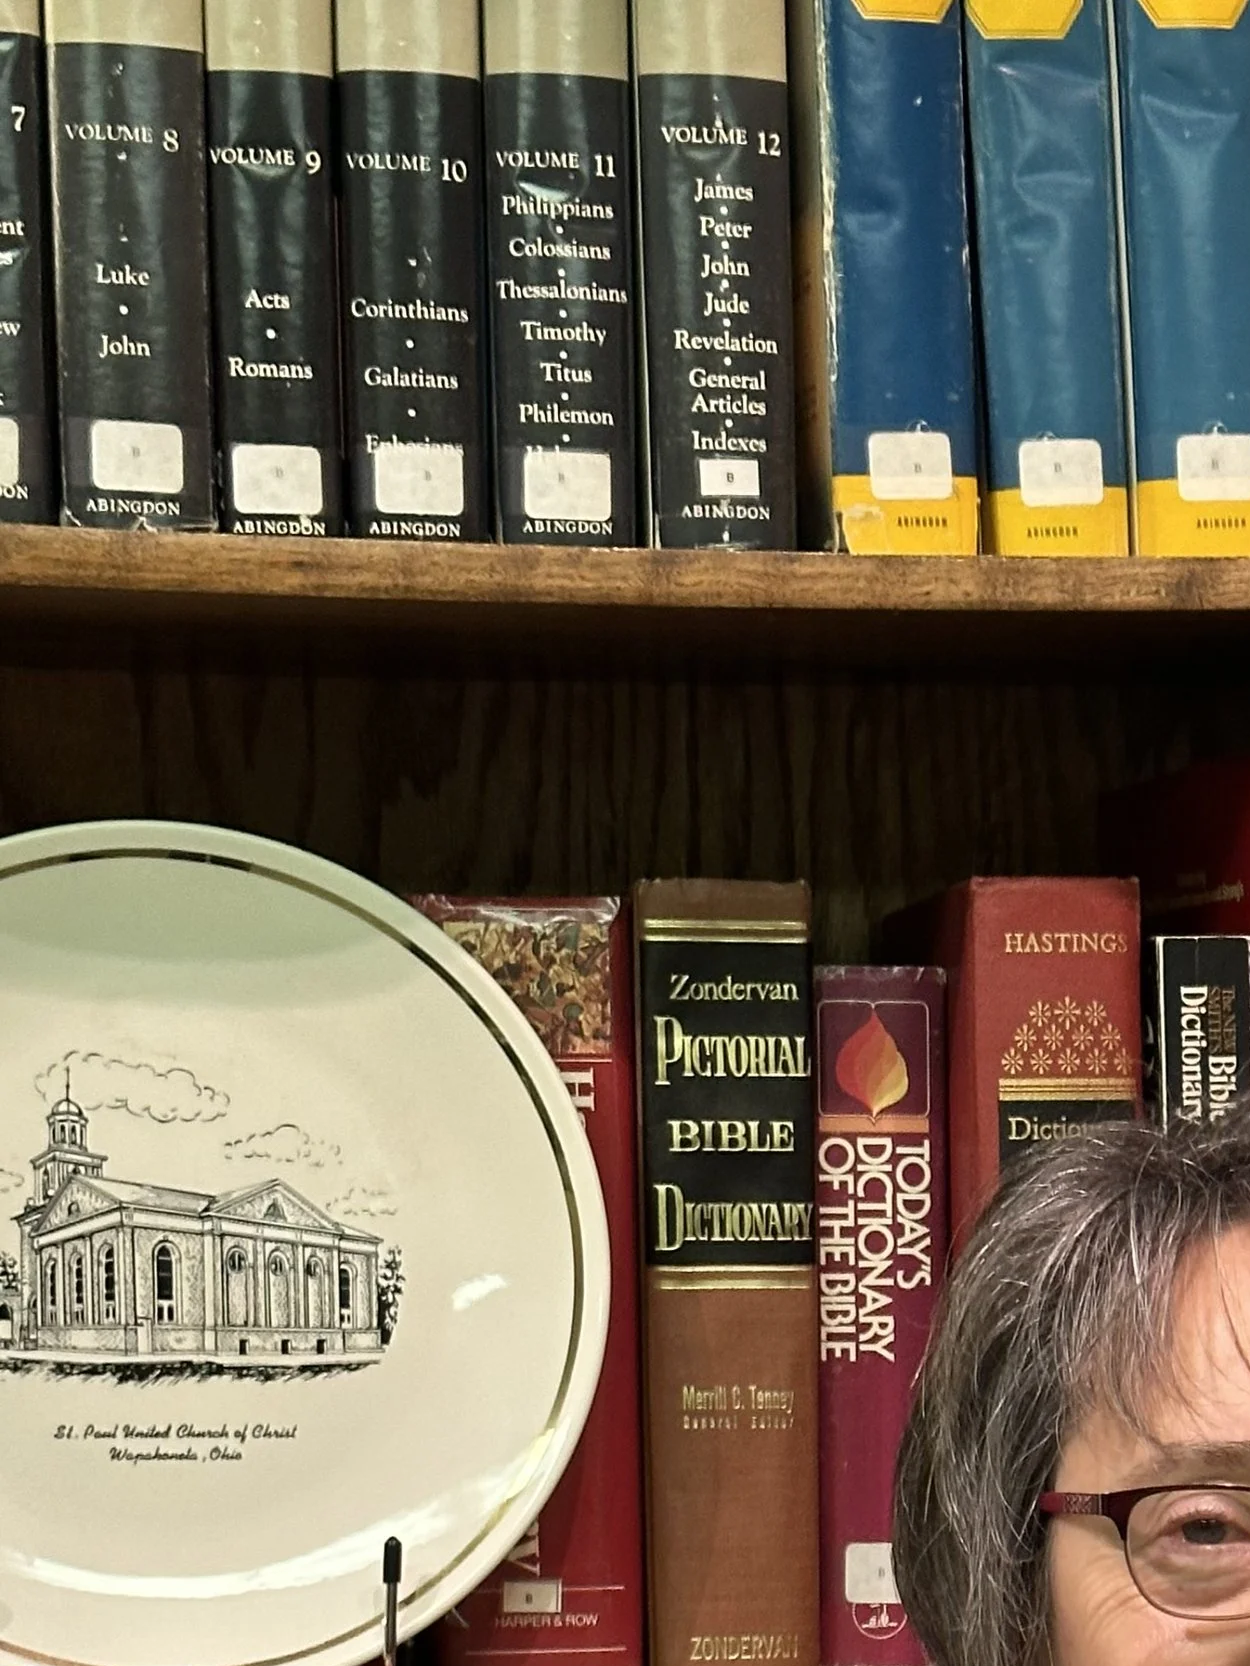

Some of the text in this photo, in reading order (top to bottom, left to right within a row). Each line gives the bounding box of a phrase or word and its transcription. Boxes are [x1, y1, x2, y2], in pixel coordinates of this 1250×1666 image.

[10, 105, 26, 132] 7
[65, 123, 180, 153] VOLUME 8
[661, 126, 782, 157] VOLUME 12
[210, 148, 322, 174] VOLUME 9
[346, 154, 467, 182] VOLUME 10
[496, 152, 616, 179] VOLUME 11
[694, 178, 754, 201] James
[502, 196, 614, 220] Philippians
[699, 218, 752, 240] Peter
[508, 238, 611, 261] Colossians
[96, 263, 150, 287] Luke
[700, 254, 750, 278] John
[245, 290, 290, 310] Acts
[497, 280, 628, 304] Thessalonians
[351, 299, 469, 324] Corinthians
[704, 293, 750, 316] Jude
[520, 321, 607, 347] Timothy
[673, 330, 778, 355] Revelation
[100, 335, 151, 358] John
[229, 358, 313, 380] Romans
[364, 366, 459, 390] Galatians
[540, 363, 592, 384] Titus
[689, 369, 766, 391] General
[519, 403, 614, 427] Philemon
[691, 396, 767, 417] Articles
[692, 431, 767, 454] Indexes
[86, 499, 181, 515] ABINGDON
[681, 504, 771, 521] ABINGDON
[233, 519, 326, 536] ABINGDON
[369, 521, 461, 537] ABINGDON
[522, 519, 613, 537] ABINGDON
[1004, 932, 1128, 954] HASTINGS
[670, 974, 799, 1002] Zondervan
[653, 1015, 811, 1087] PICTORIAL
[1175, 985, 1208, 1126] Dictionary
[668, 1120, 794, 1152] BIBLE
[654, 1184, 813, 1252] DICTIONARY
[895, 1139, 932, 1290] TODAY'S
[818, 1137, 857, 1363] OF THE BIBLE
[856, 1137, 895, 1363] DICTIONARY
[682, 1385, 727, 1411] Merrill
[732, 1385, 745, 1410] C.
[84, 1424, 118, 1440] Paul
[122, 1424, 171, 1439] United
[176, 1424, 229, 1440] Church
[234, 1424, 248, 1443] of
[252, 1424, 298, 1439] Christ
[210, 1446, 242, 1462] Ohio
[496, 1612, 599, 1628] HARPER & ROW
[690, 1635, 799, 1662] ZONDERVAN
